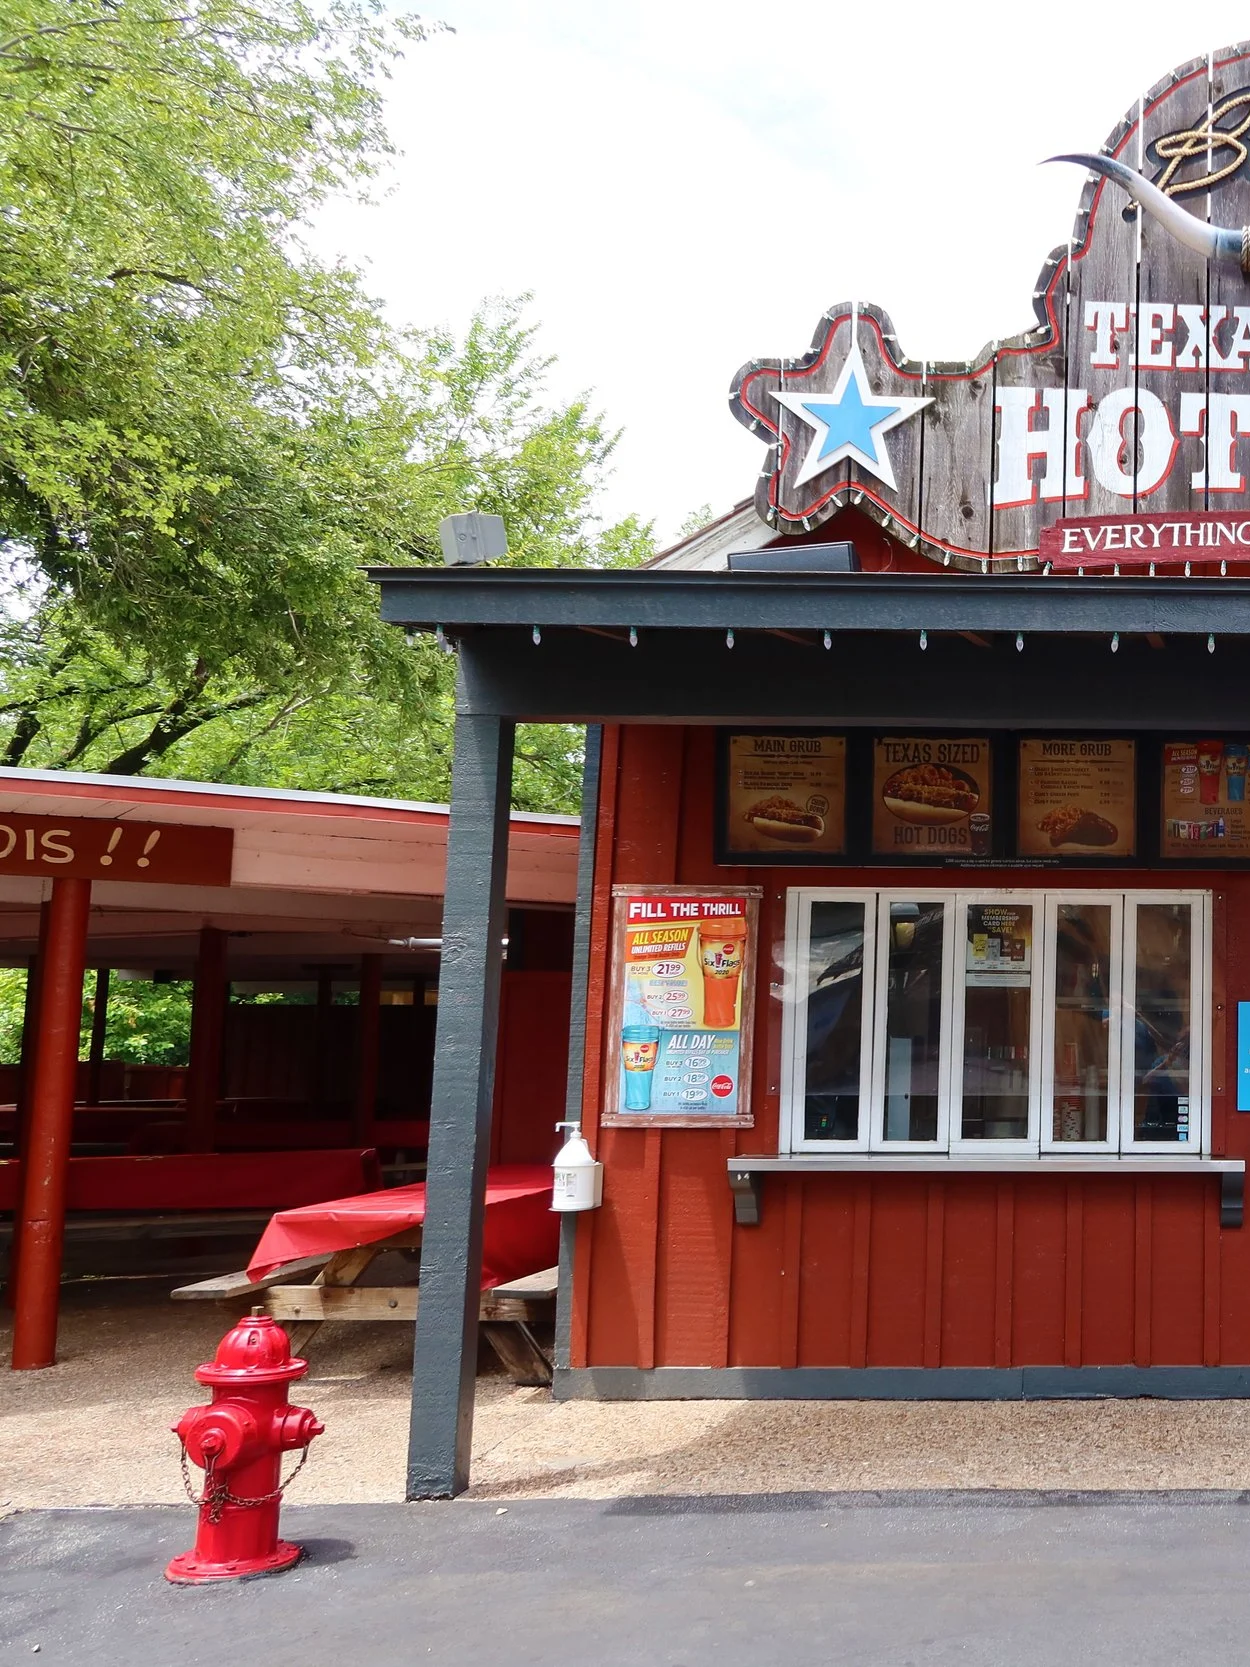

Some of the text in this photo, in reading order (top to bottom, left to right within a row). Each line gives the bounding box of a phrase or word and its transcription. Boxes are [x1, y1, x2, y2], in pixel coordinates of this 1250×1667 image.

[754, 739, 821, 753] MAIN GRUB
[883, 743, 980, 763] TEXAS SIZED
[1042, 743, 1112, 756] MORE GRUB
[1204, 807, 1243, 815] BEVERAGES
[893, 826, 967, 845] HOT DOGS
[629, 902, 741, 919] FILL THE THRILL
[632, 929, 689, 945] ALL SEASON
[631, 942, 686, 954] UNLIMITED REFILLS
[704, 958, 741, 969] Six Flags
[668, 1034, 690, 1049] ALL
[691, 1034, 716, 1049] DAY
